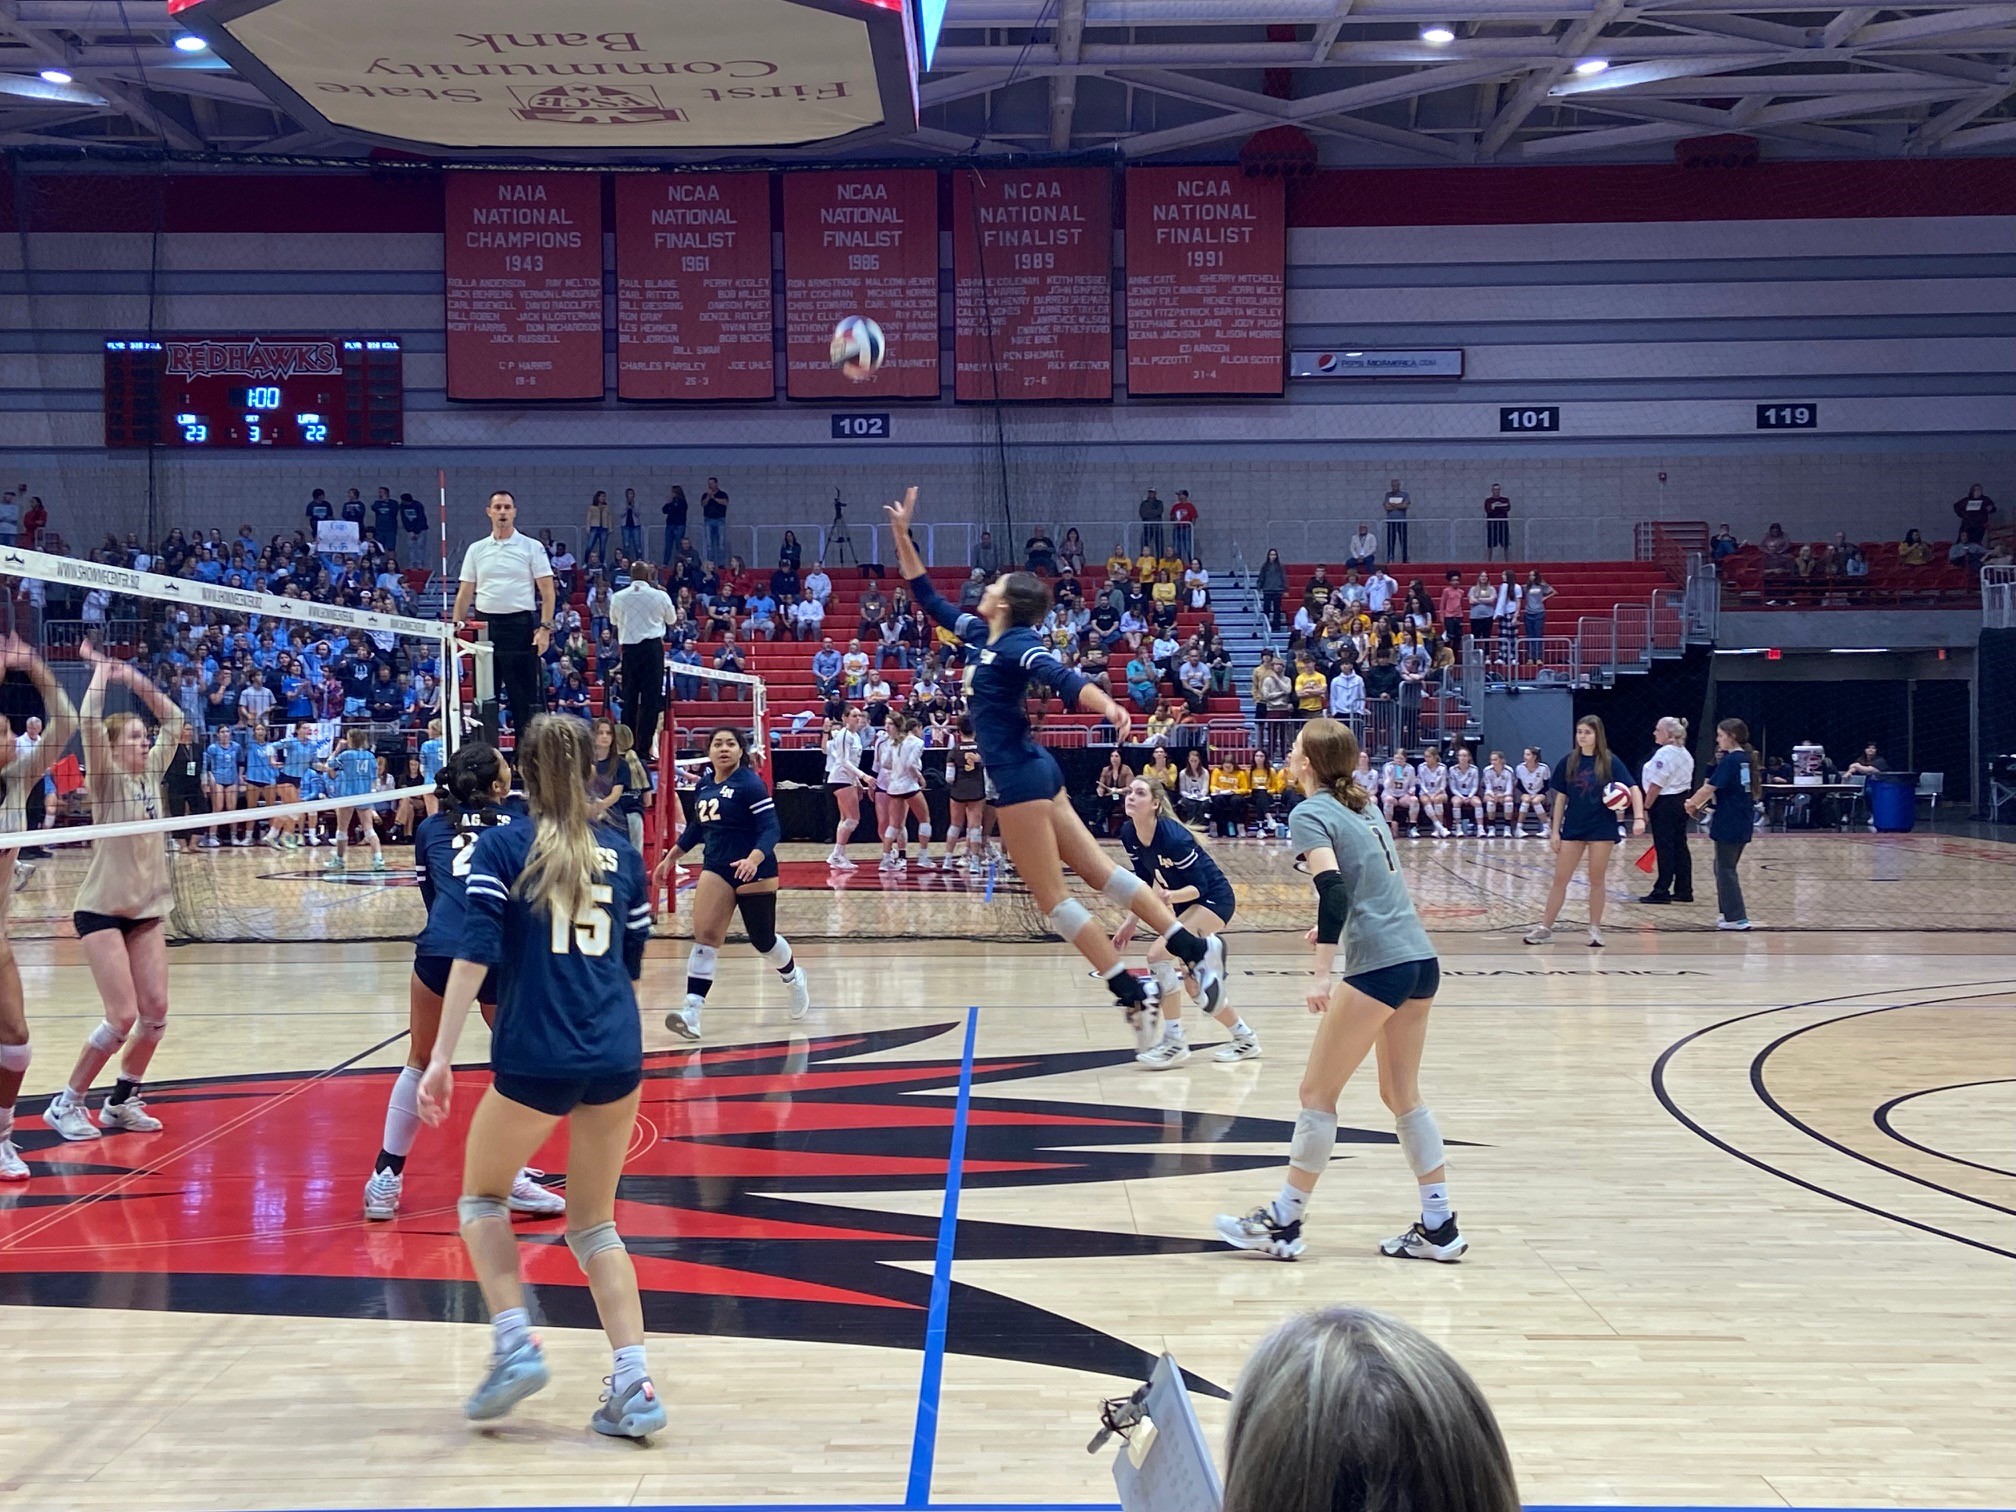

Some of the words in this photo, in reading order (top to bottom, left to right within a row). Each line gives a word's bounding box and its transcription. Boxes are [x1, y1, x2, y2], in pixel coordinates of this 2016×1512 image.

[455, 32, 647, 53] Bank
[363, 58, 778, 79] Community
[314, 82, 482, 103] State
[700, 81, 853, 101] First
[499, 185, 546, 201] NAIA
[668, 185, 720, 201] NCAA
[837, 184, 887, 200] NCAA
[1004, 182, 1061, 199] NCAA
[1178, 180, 1231, 197] NCAA
[473, 208, 573, 225] NATIONAL
[652, 209, 737, 225] NATIONAL
[821, 208, 903, 224] NATIONAL
[981, 206, 1086, 223] NATIONAL
[1153, 204, 1257, 221] NATIONAL
[467, 232, 581, 248] CHAMPIONS
[655, 232, 735, 248] FINALIST
[823, 231, 902, 247] FINALIST
[985, 229, 1082, 246] FINALIST
[1157, 227, 1253, 244] FINALIST
[505, 256, 543, 271] 1943
[681, 256, 709, 272] 1961
[848, 255, 879, 270] 1986
[1015, 253, 1054, 269] 1989
[1187, 251, 1223, 267] 1991
[619, 279, 642, 288] PAUL
[703, 279, 732, 287] PERRY
[618, 291, 643, 299] CARL
[646, 291, 680, 299] RITTER
[448, 301, 470, 309] CARL
[516, 312, 540, 321] JACK
[490, 335, 514, 343] JACK
[517, 335, 560, 343] RUSSELL
[619, 335, 640, 343] BILL
[168, 339, 338, 377] REDHAWKS
[673, 346, 693, 355] BILL
[499, 361, 505, 370] C
[508, 361, 514, 370] P
[518, 361, 552, 370] HARRIS
[620, 362, 662, 370] CHARLES
[664, 362, 706, 370] PARSLEY
[728, 361, 746, 369] JOE
[1193, 370, 1216, 378] 31-4
[248, 387, 280, 408] 1:00
[1508, 412, 1551, 428] 101
[1765, 408, 1809, 425] 119
[186, 425, 207, 441] 23
[249, 426, 260, 442] 3
[306, 425, 326, 441] 22
[840, 418, 882, 434] 102
[698, 798, 721, 822] 22
[549, 884, 613, 956] 15
